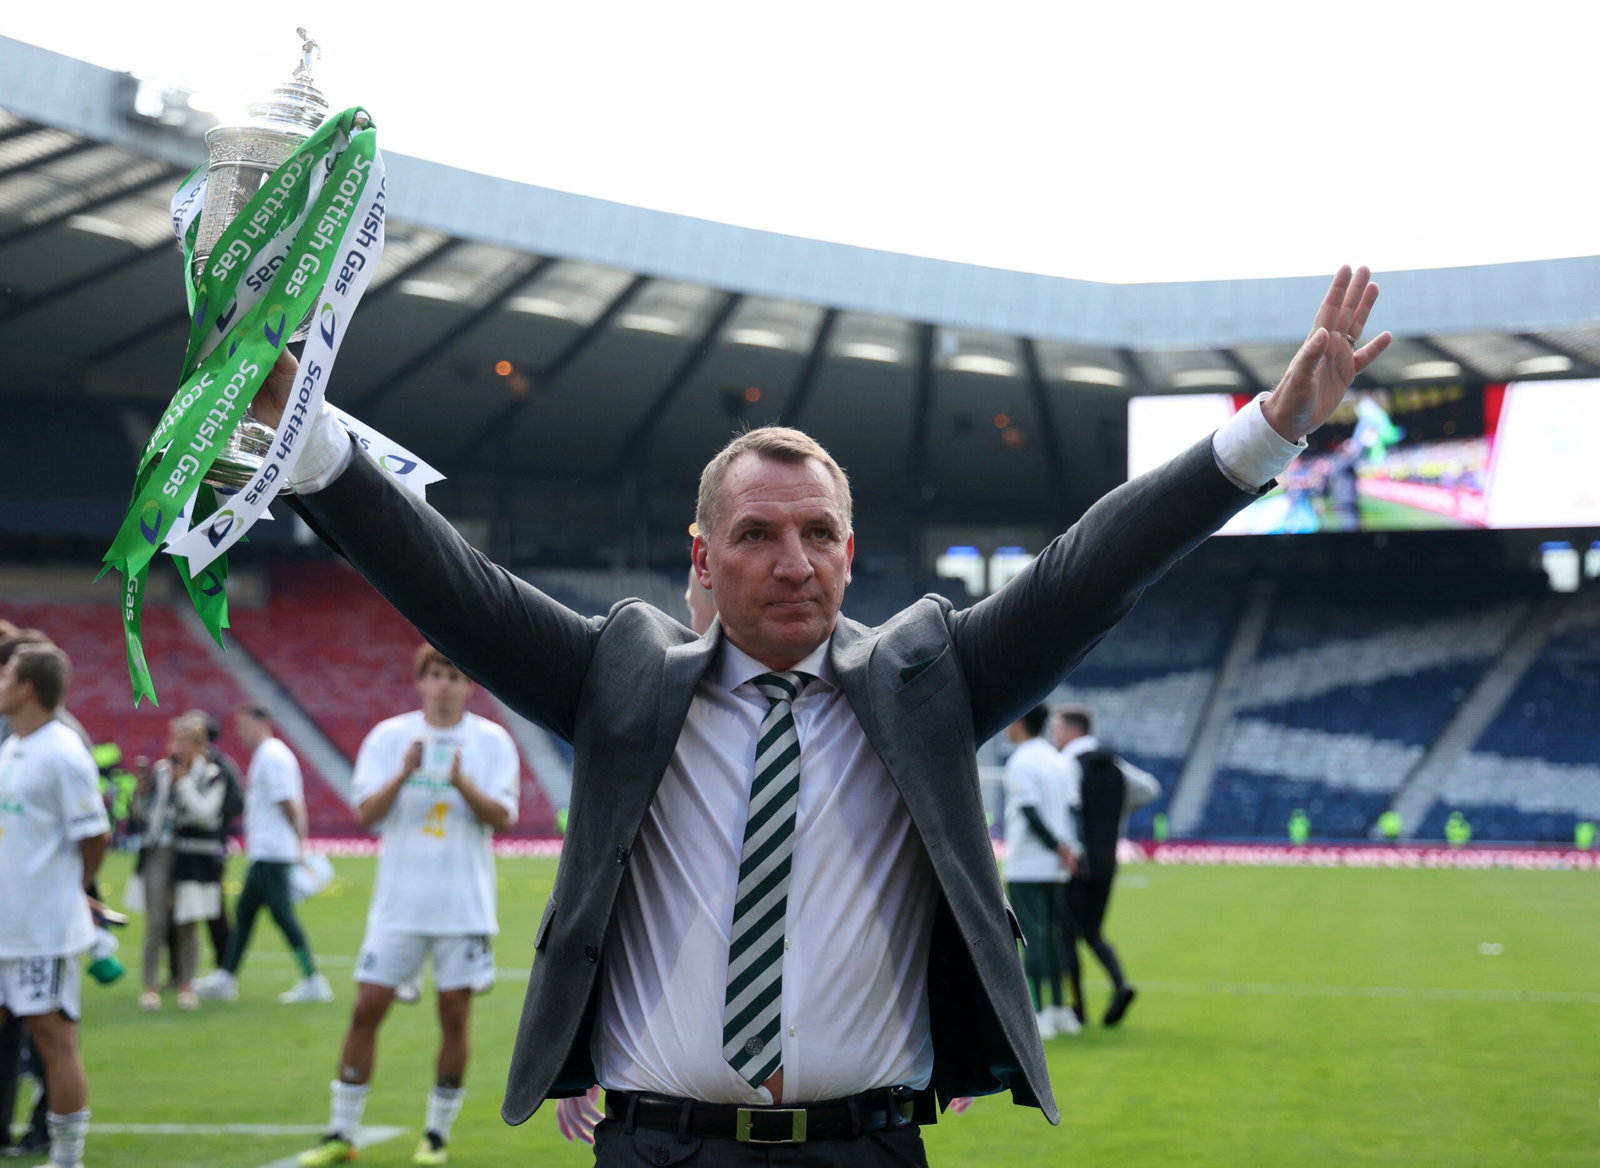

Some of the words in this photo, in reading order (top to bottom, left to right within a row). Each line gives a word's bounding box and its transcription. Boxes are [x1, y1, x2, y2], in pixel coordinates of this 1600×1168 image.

[243, 153, 314, 239] Scottish
[309, 154, 373, 250] Scottish
[211, 239, 251, 282] Gas
[246, 255, 286, 292] Gas
[285, 253, 321, 298] Gas
[335, 250, 366, 296] Gas
[190, 358, 259, 453] Scottish
[277, 360, 322, 460] Scottish
[162, 454, 200, 498] Gas
[244, 463, 280, 505] Gas
[126, 577, 138, 621] Gas
